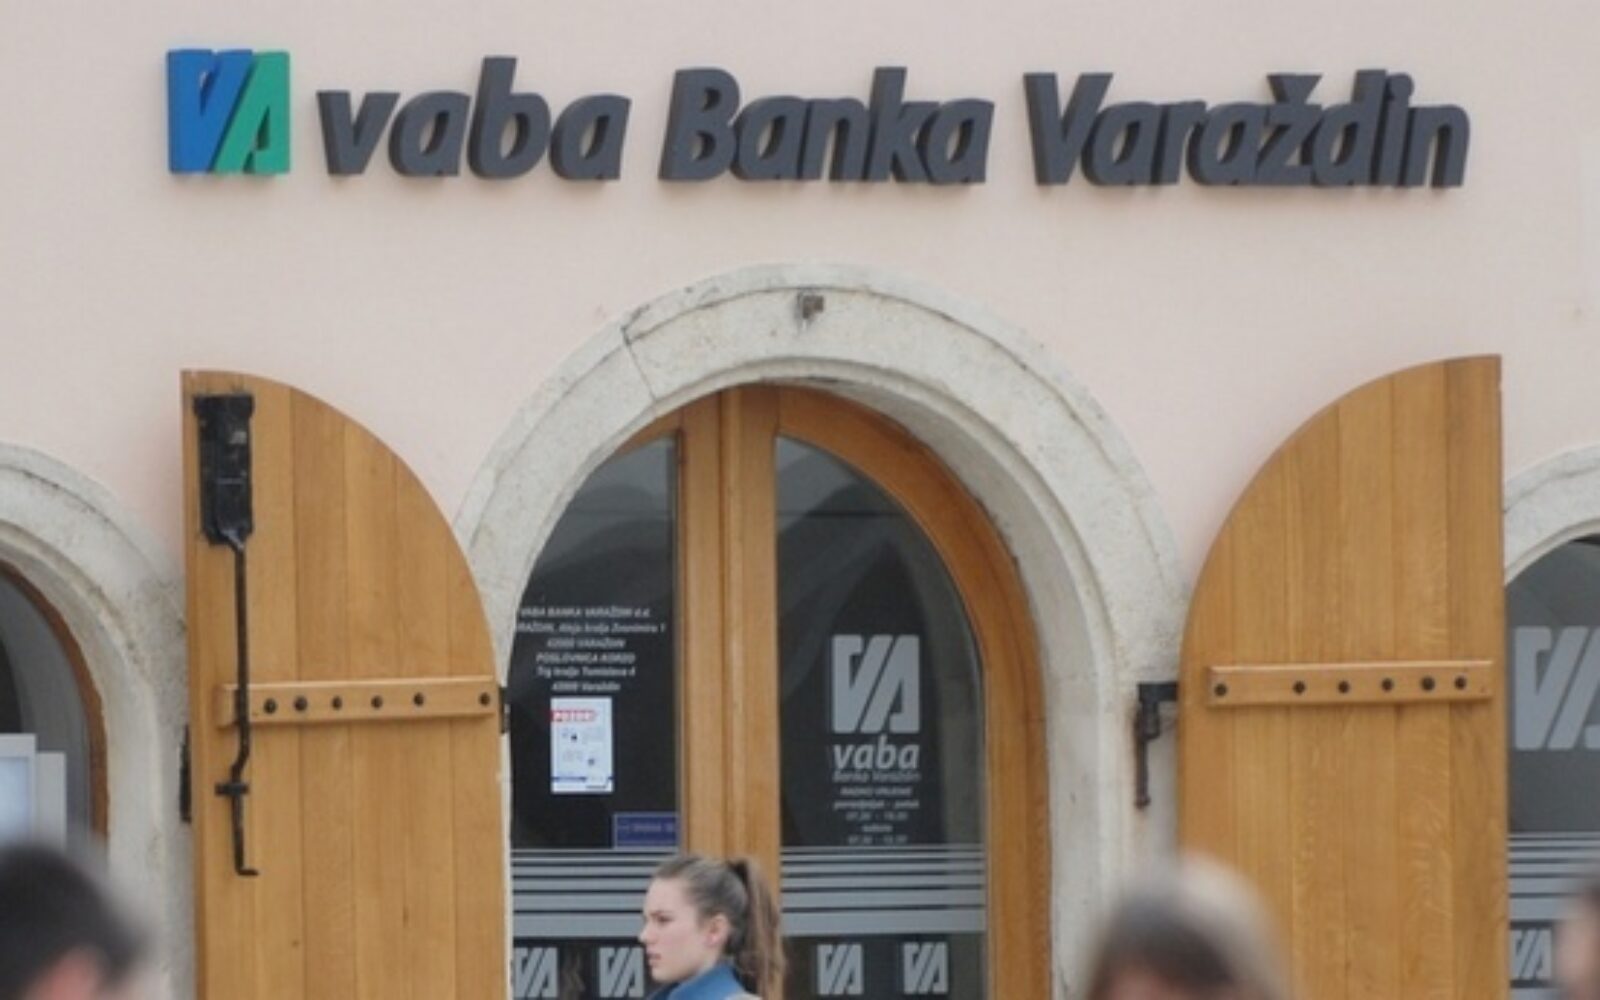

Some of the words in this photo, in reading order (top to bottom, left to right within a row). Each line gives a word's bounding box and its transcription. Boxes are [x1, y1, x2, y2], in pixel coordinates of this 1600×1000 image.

[317, 56, 630, 182] vaba
[658, 66, 995, 186] Banka
[1023, 70, 1471, 190] Varaždin
[833, 734, 920, 769] vaba
